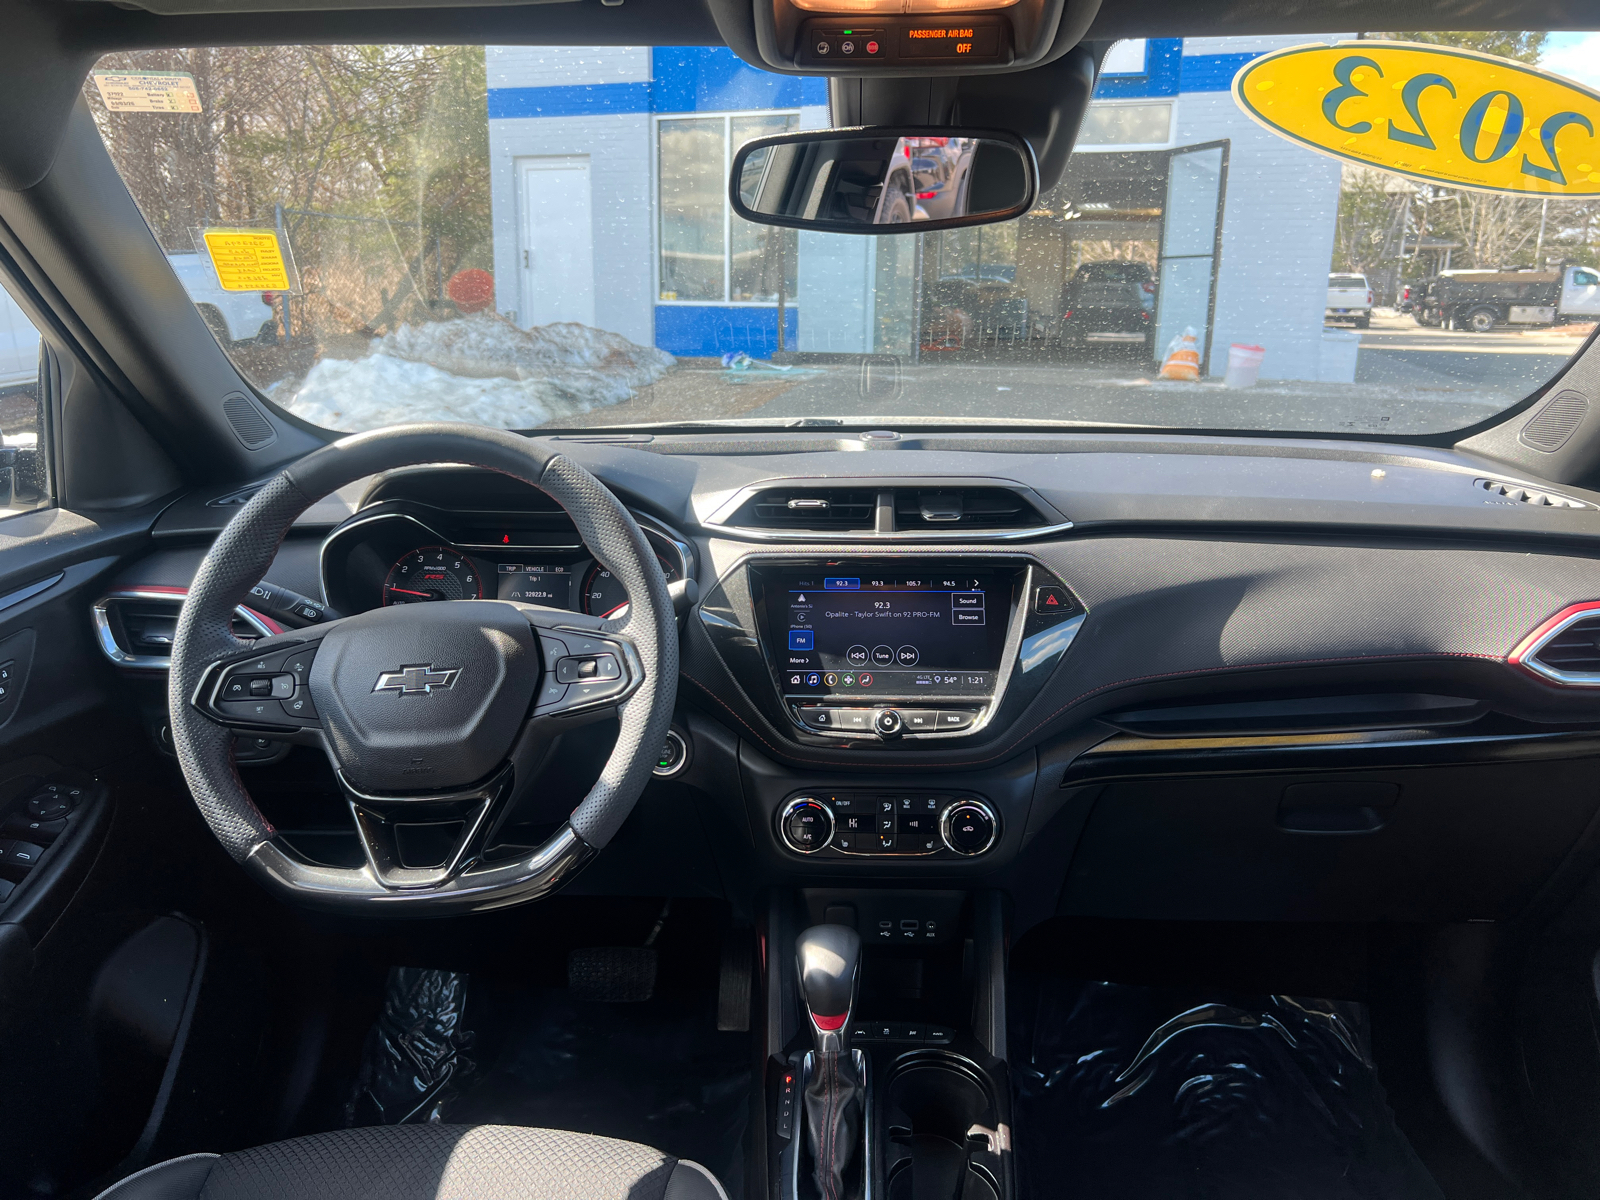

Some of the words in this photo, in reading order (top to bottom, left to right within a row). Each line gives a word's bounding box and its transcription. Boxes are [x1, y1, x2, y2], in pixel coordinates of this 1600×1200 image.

[909, 29, 947, 39] PASSENGER
[947, 29, 960, 38] AIR
[960, 29, 973, 38] BAG
[956, 43, 972, 54] OFF
[417, 555, 424, 563] 3
[401, 565, 408, 573] 2
[454, 561, 461, 569] 5
[466, 575, 473, 583] 6
[529, 575, 537, 583] Trip
[874, 601, 891, 609] 92.3
[824, 610, 849, 619] Opalite
[854, 610, 874, 619] Taylor
[875, 610, 892, 618] Swift
[967, 676, 984, 684] 1:21
[785, 1076, 792, 1084] P
